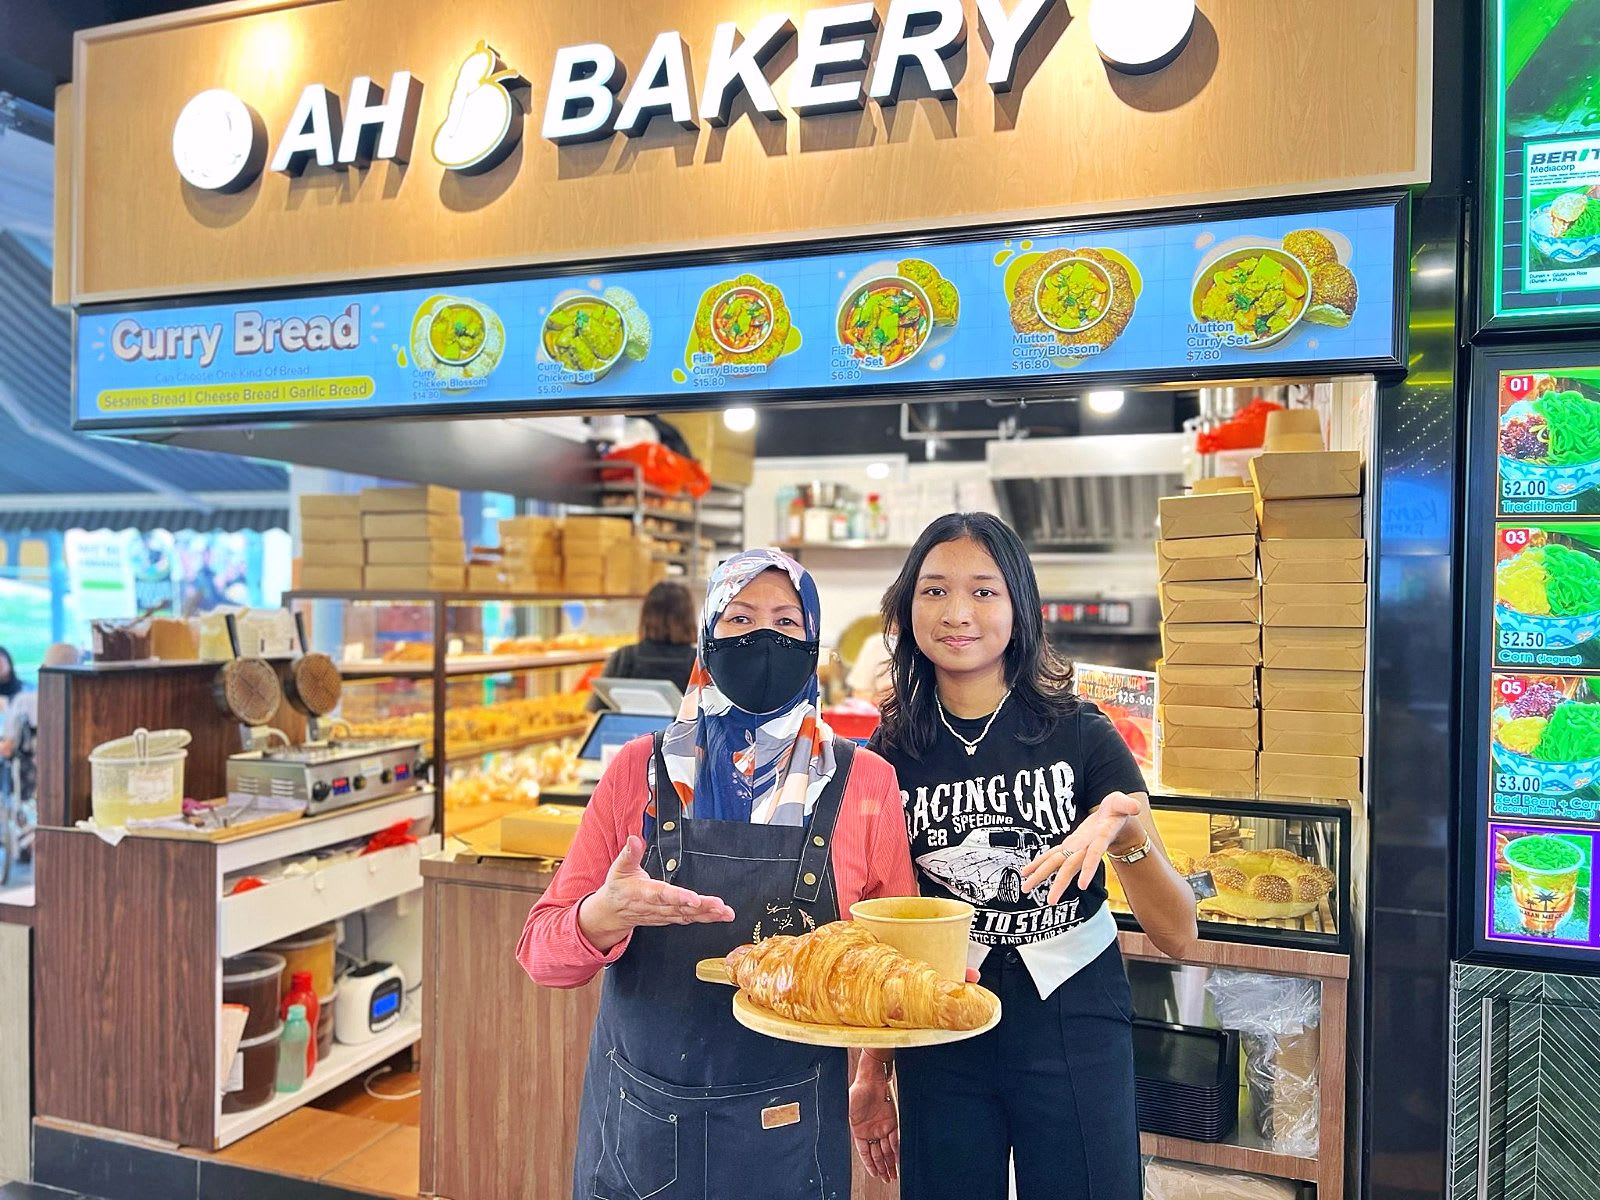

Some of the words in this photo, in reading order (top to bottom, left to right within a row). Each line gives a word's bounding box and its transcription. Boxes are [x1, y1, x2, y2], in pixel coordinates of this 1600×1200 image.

[271, 71, 413, 173] AH
[542, 0, 1060, 139] BAKERY
[1530, 164, 1575, 173] Mediacorp
[1187, 321, 1234, 334] Mutton
[111, 319, 223, 368] Curry
[233, 303, 361, 355] Bread
[1012, 333, 1055, 344] Mutton
[1187, 335, 1225, 348] Curry
[1227, 334, 1249, 346] Set
[831, 346, 853, 356] Fish
[1012, 346, 1047, 358] Curry
[1048, 343, 1100, 356] Blossom
[1187, 350, 1220, 361] $7.80
[693, 354, 714, 364] Fish
[831, 358, 860, 369] Curry
[865, 356, 883, 367] Set
[1012, 359, 1049, 370] $16.80
[155, 372, 174, 384] Can
[176, 370, 212, 382] Choose
[216, 368, 237, 380] One
[239, 367, 265, 379] Kind
[267, 366, 278, 377] Of
[280, 364, 310, 376] Bread
[412, 369, 435, 379] Curry
[537, 363, 563, 373] Curry
[693, 366, 720, 377] Curry
[722, 363, 766, 374] Blossom
[537, 373, 574, 383] Chicken
[578, 372, 594, 382] Set
[693, 377, 725, 387] $15.80
[831, 370, 860, 381] $6.80
[412, 379, 447, 388] Chicken
[450, 378, 487, 388] Blossom
[537, 384, 563, 394] $5.80
[1510, 378, 1528, 391] 01
[105, 393, 149, 408] Sesame
[152, 391, 186, 406] Bread
[195, 389, 239, 404] Cheese
[243, 387, 279, 402] Bread
[289, 384, 325, 398] Garlic
[329, 382, 367, 397] Bread
[1504, 480, 1545, 496] $2.00
[1503, 500, 1576, 512] Traditional
[1505, 531, 1526, 544] 03
[1503, 632, 1544, 647] $2.50
[1499, 651, 1534, 662] Corn
[1537, 654, 1582, 665] (Jagung)
[1501, 681, 1521, 694] 05
[1499, 776, 1540, 792] $3.00
[1013, 761, 1077, 835] CAR
[1495, 794, 1521, 804] Red
[1523, 796, 1556, 807] Bean
[952, 814, 1014, 833] SPEEDING
[927, 828, 948, 846] 28
[985, 912, 1011, 933] TO
[1015, 900, 1080, 934] START
[1000, 935, 1022, 945] AND
